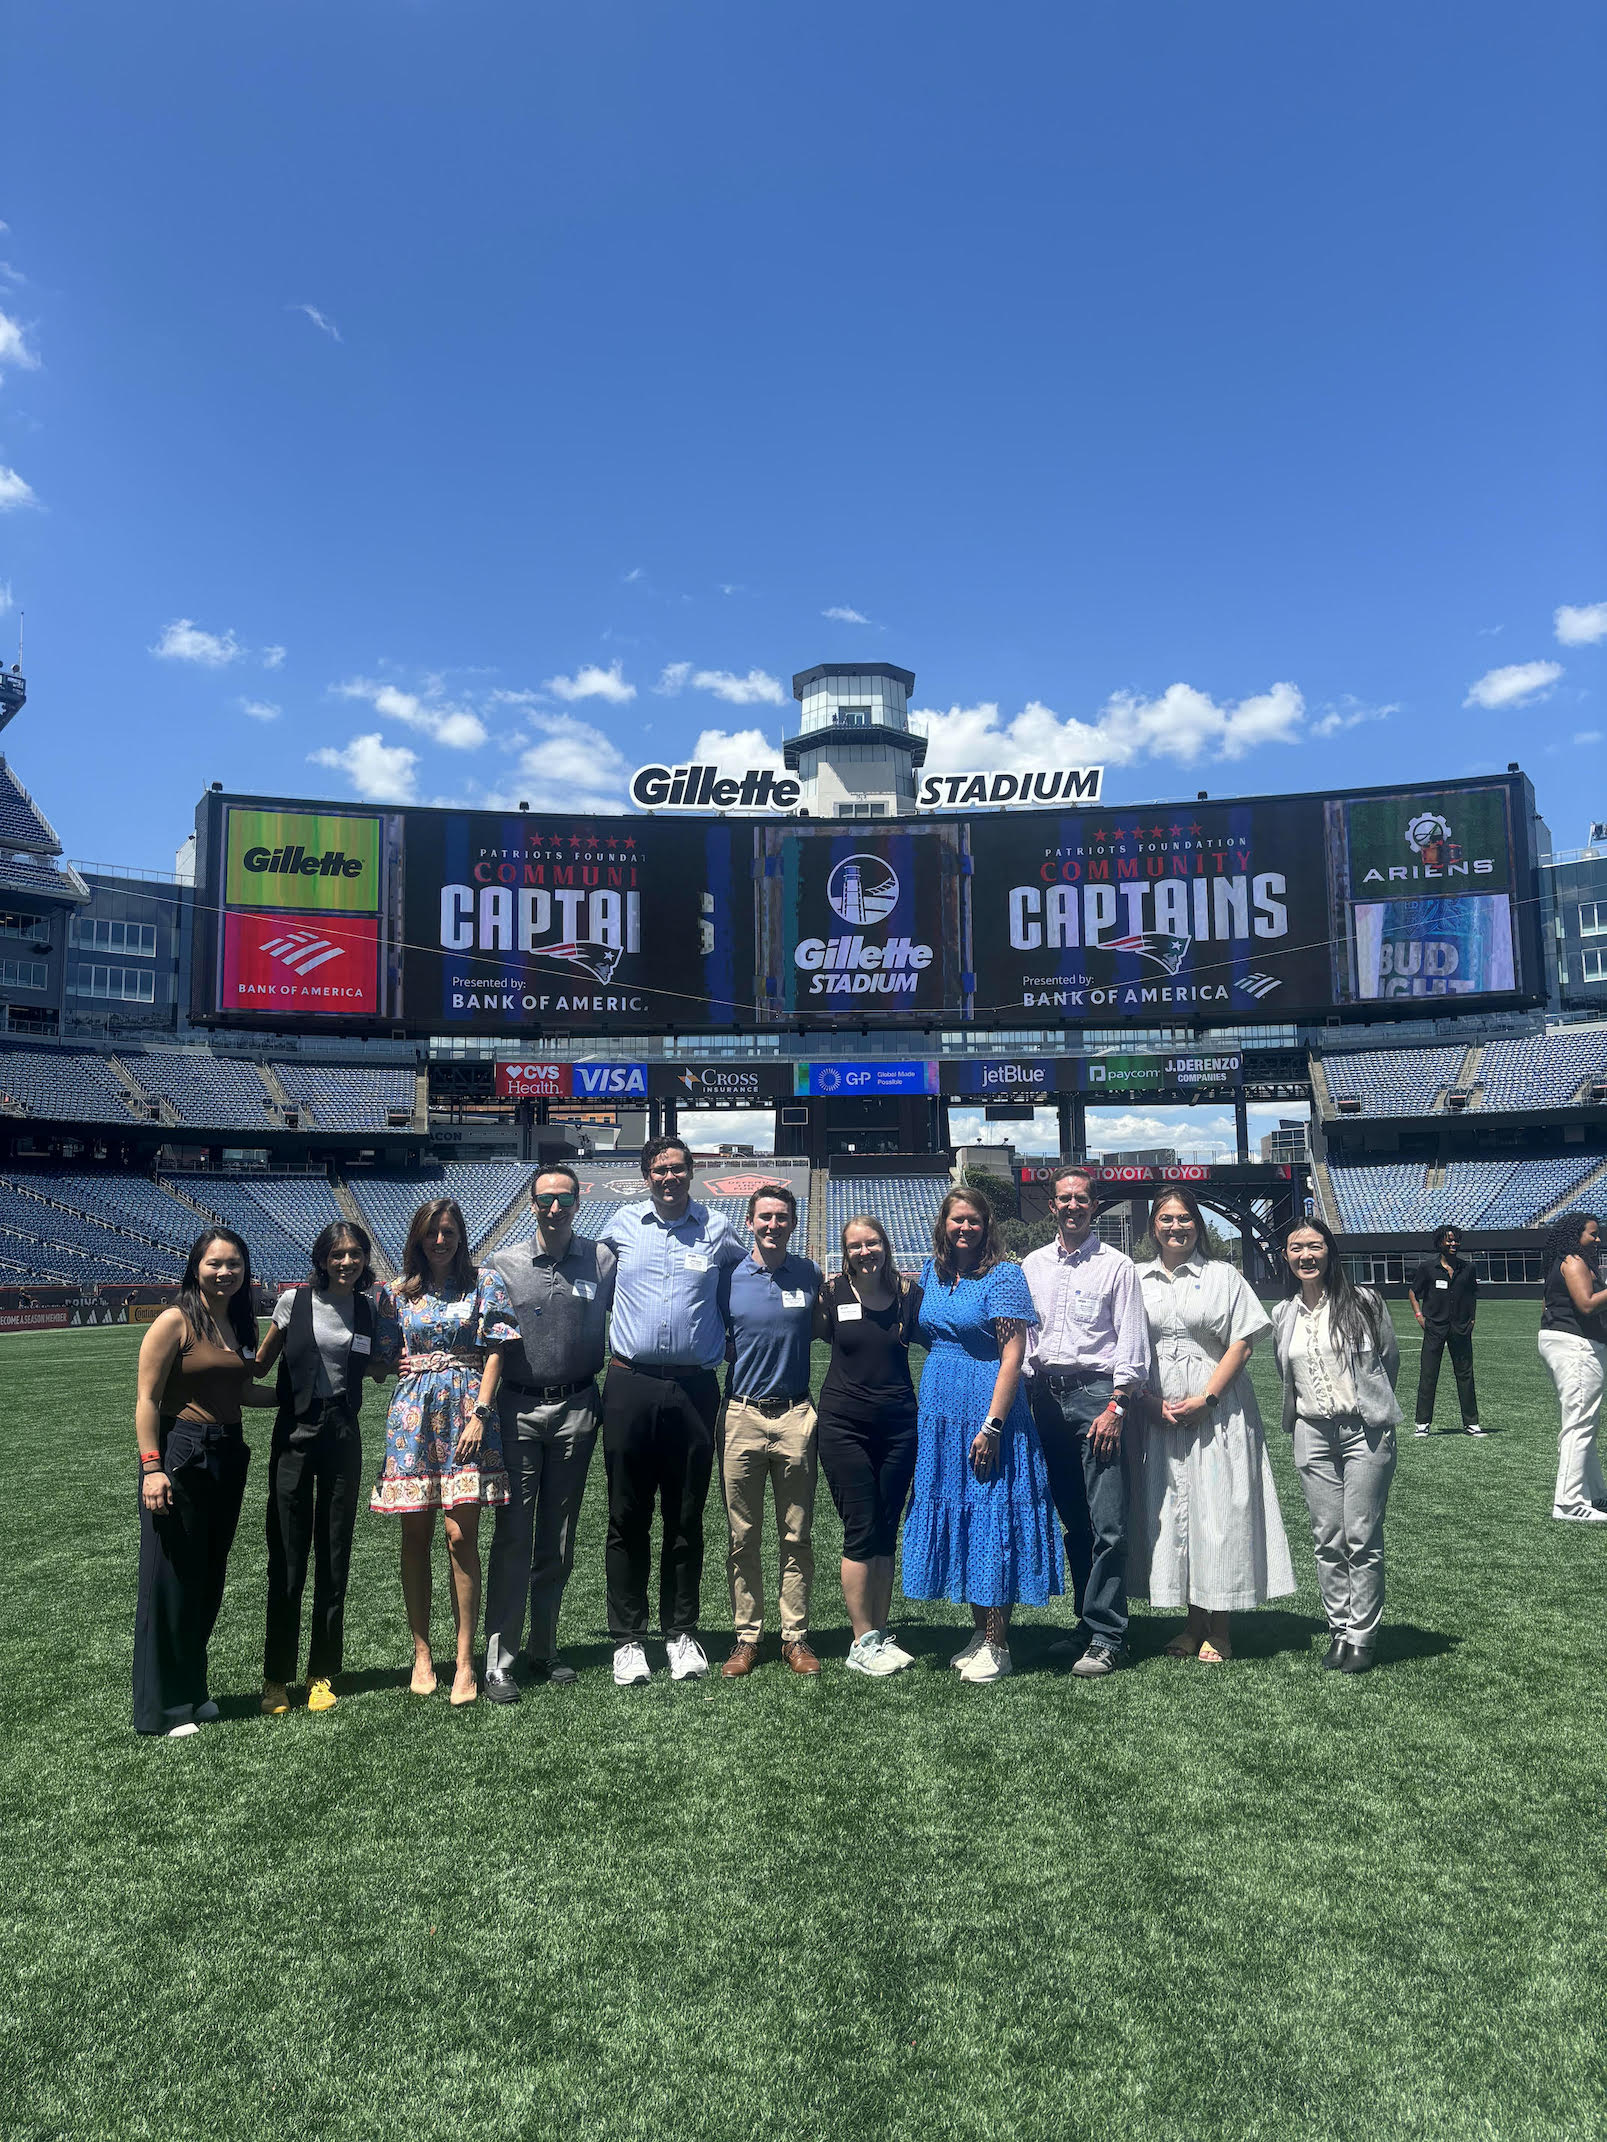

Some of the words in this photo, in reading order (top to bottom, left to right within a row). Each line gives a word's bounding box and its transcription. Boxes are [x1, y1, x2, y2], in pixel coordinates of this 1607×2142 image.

[632, 765, 801, 808] Gillette
[920, 769, 1101, 805] STADIUM
[480, 849, 563, 860] PATRIOTS
[1045, 845, 1127, 857] PATRIOTS
[1138, 837, 1247, 852] FOUNDATION
[243, 845, 363, 878] Gillette
[1040, 851, 1251, 882] COMMUNITY
[1362, 860, 1495, 882] ARIENS
[1008, 872, 1288, 951] CAPTAINS
[794, 936, 934, 970] Gillette
[1379, 941, 1459, 976] BUD
[452, 976, 508, 988] Presented
[510, 978, 526, 990] by:
[808, 972, 919, 994] STADIUM
[1022, 975, 1076, 986] Presented
[1078, 974, 1094, 986] by:
[238, 984, 276, 995] BANK
[280, 985, 298, 996] OF
[301, 986, 364, 998] AMERICA
[1023, 991, 1084, 1007] BANK
[1090, 989, 1119, 1005] OF
[1124, 985, 1229, 1003] AMERICA
[452, 993, 515, 1010] BANK
[521, 995, 550, 1011] OF
[556, 996, 649, 1012] AMERIC
[523, 1065, 560, 1080] CVS
[1108, 1068, 1160, 1083] paycom
[1164, 1057, 1240, 1073] J.DERENZO
[575, 1068, 646, 1092] VISA
[982, 1064, 1045, 1088] jetBlue
[1177, 1072, 1227, 1083] COMPANIES
[1095, 1167, 1154, 1180] TOYOTA
[1159, 1166, 1210, 1180] TOYOT
[0, 1315, 20, 1326] ECOME
